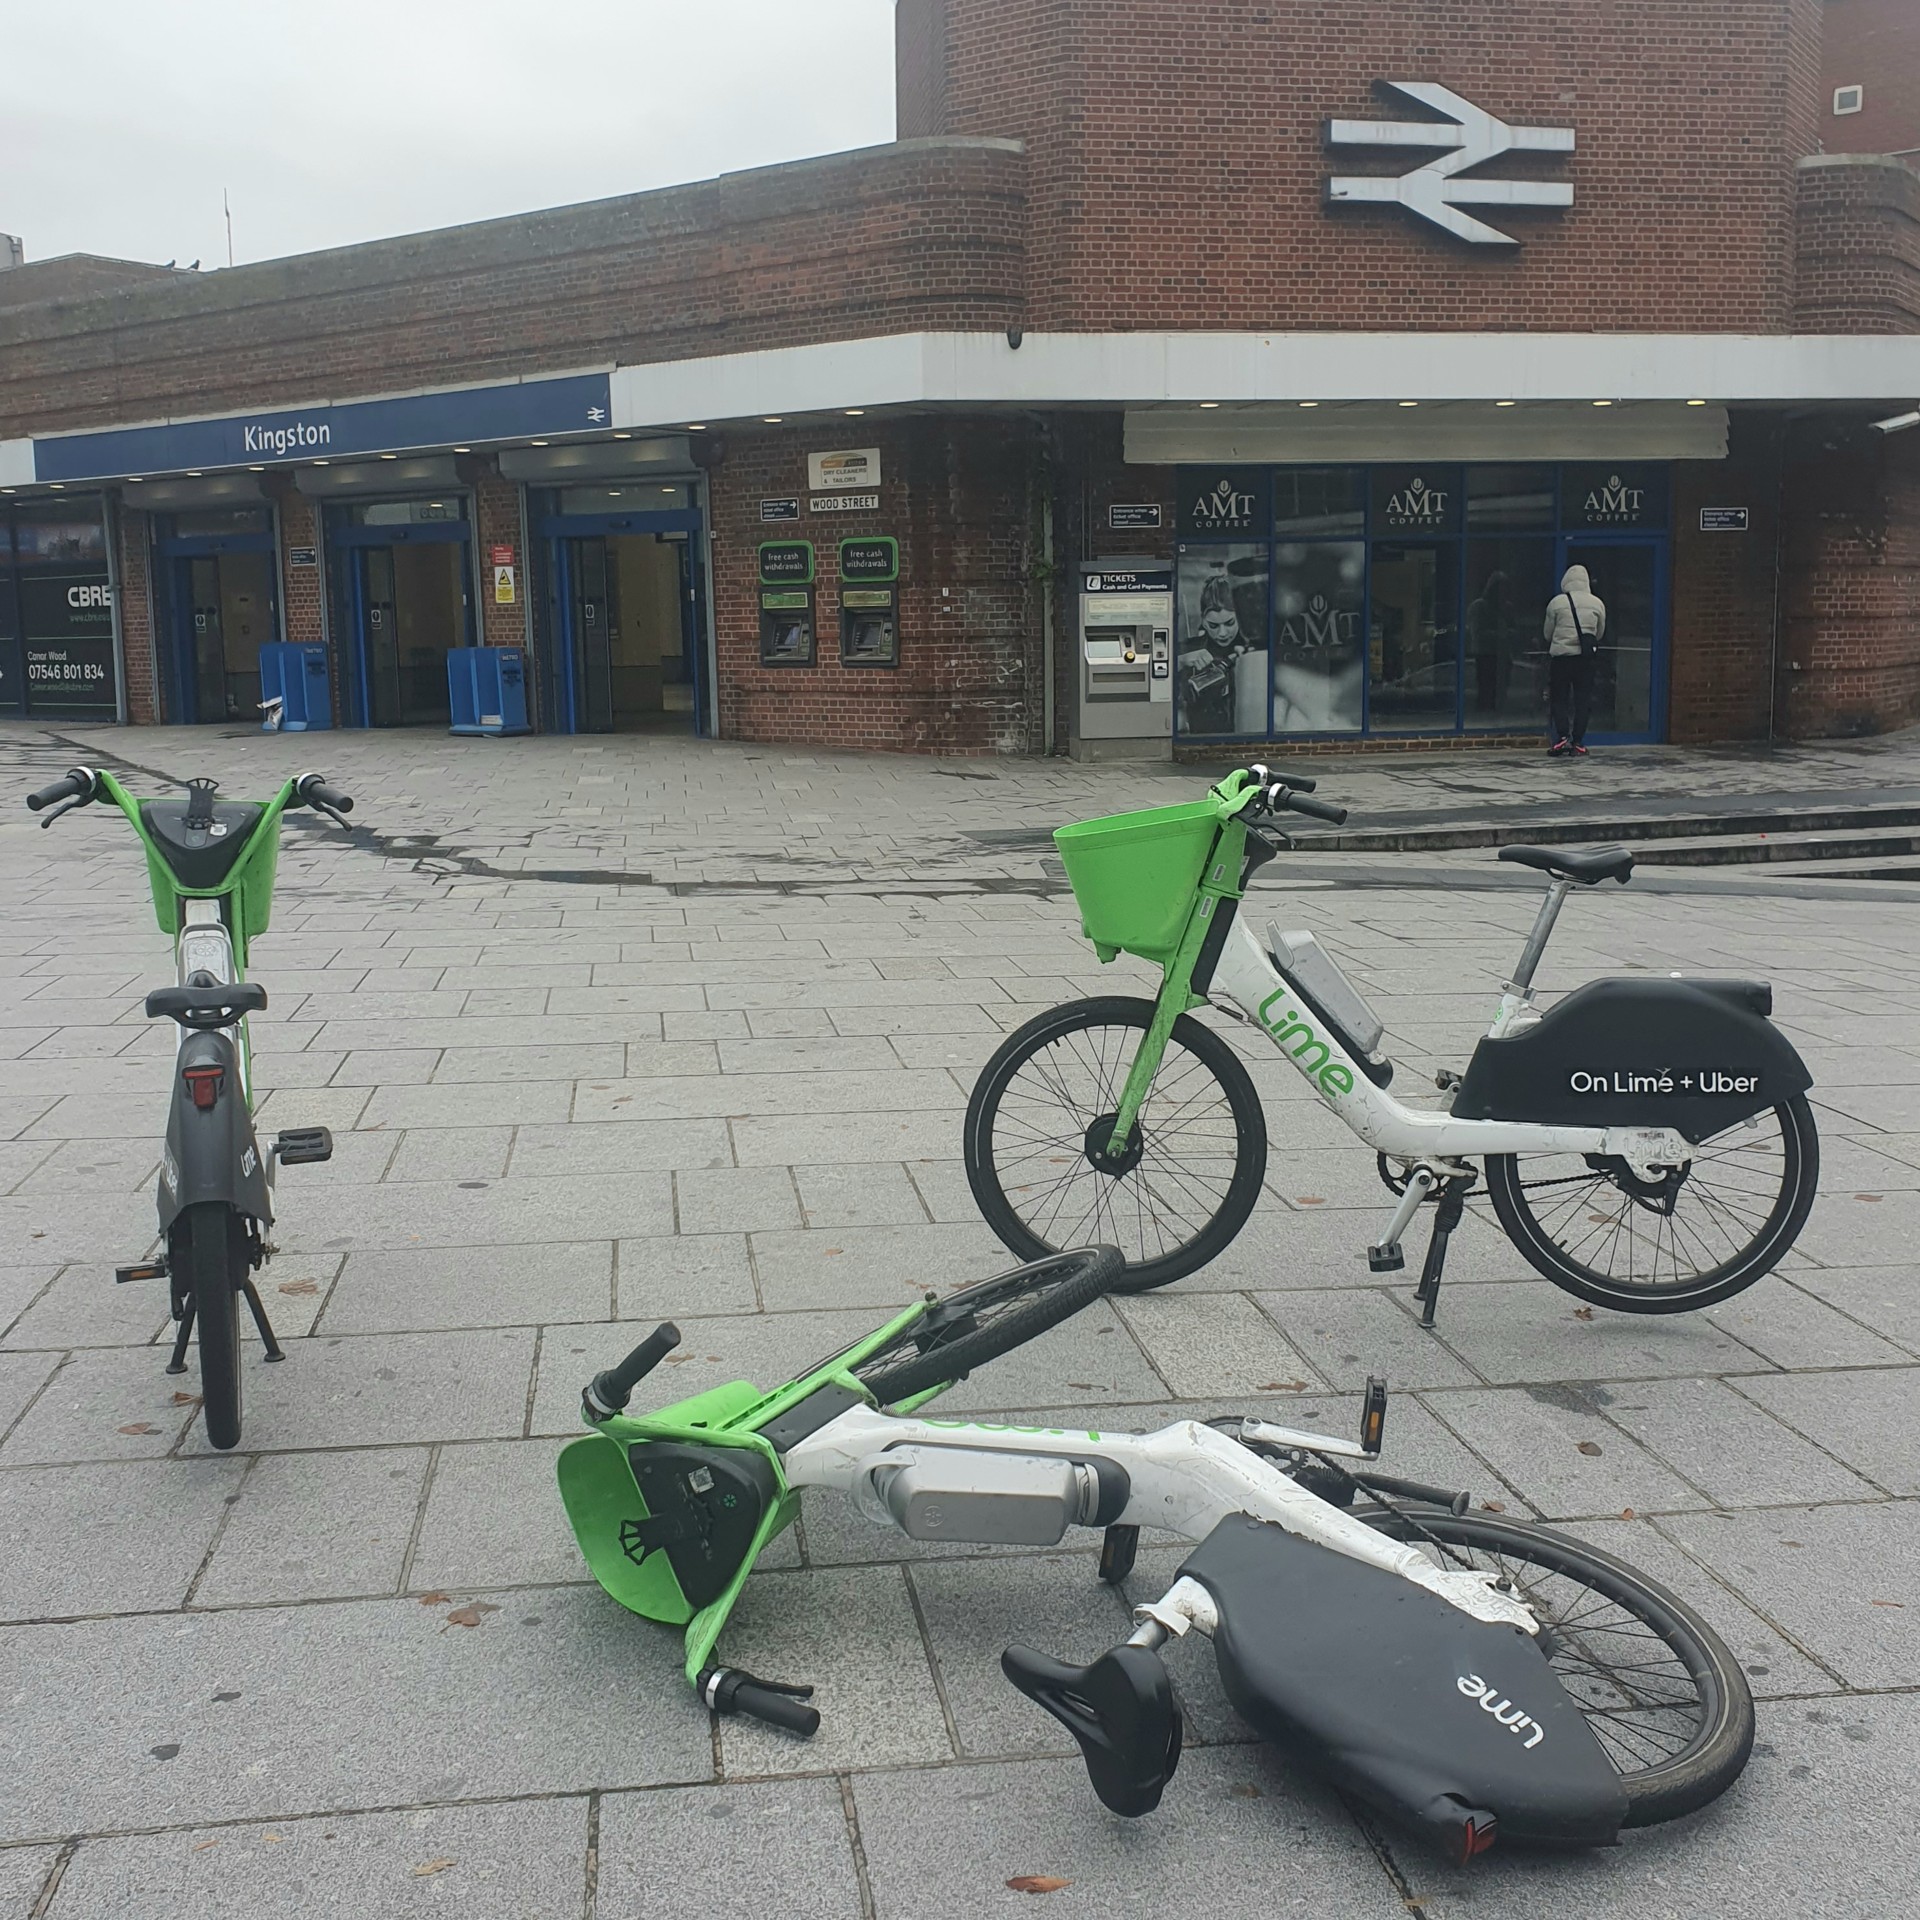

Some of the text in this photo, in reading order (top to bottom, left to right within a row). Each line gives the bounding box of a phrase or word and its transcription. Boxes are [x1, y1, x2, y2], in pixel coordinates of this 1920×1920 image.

[244, 422, 330, 455] Kingston
[836, 467, 867, 475] CLEANERS
[812, 496, 876, 510] WOOD STREET
[1192, 492, 1255, 518] AMT
[1386, 489, 1448, 515] AMT
[1584, 487, 1644, 512] AMT
[1195, 520, 1250, 528] COFFEE
[1389, 516, 1441, 525] COFFEE
[1587, 513, 1639, 521] COFFEE
[783, 552, 799, 560] cash
[850, 549, 883, 558] free cash
[764, 562, 804, 571] withdrawals
[846, 559, 887, 568] withdrawals
[1102, 574, 1136, 582] TICKETS
[67, 585, 111, 608] CBRE
[1280, 610, 1360, 648] AMT
[27, 651, 67, 661] Conor Wood
[28, 664, 104, 679] 07546 801 834
[1259, 987, 1354, 1097] Lime
[1570, 1071, 1759, 1093] On Lime + Uber
[1457, 1673, 1545, 1749] Lime
